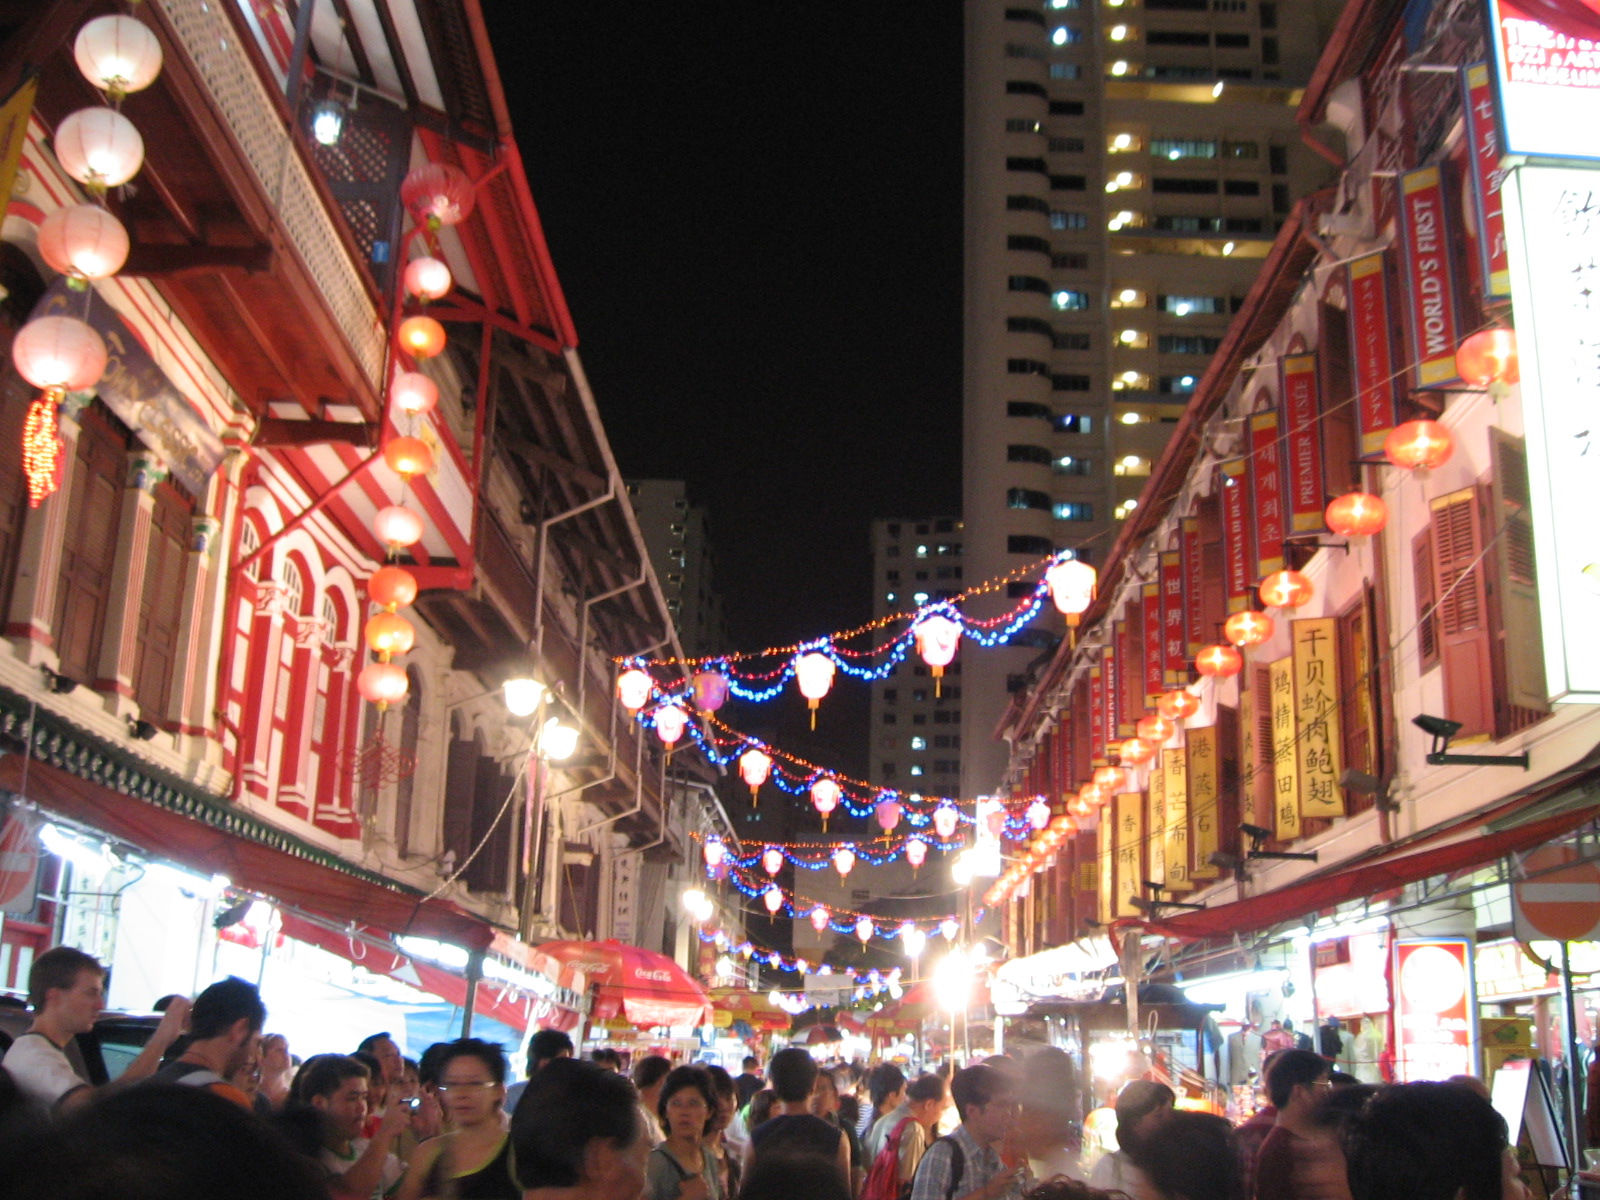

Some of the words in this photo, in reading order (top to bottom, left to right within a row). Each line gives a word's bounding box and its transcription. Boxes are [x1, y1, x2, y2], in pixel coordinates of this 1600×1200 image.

[1511, 62, 1600, 87] MUSEUM
[1414, 199, 1438, 254] FIRST
[1420, 258, 1447, 356] WORLD'S
[1294, 379, 1309, 431] MUSÉE
[1297, 437, 1314, 506] PREMIER
[1230, 486, 1241, 518] DUNI
[1232, 535, 1245, 592] PERTAMA
